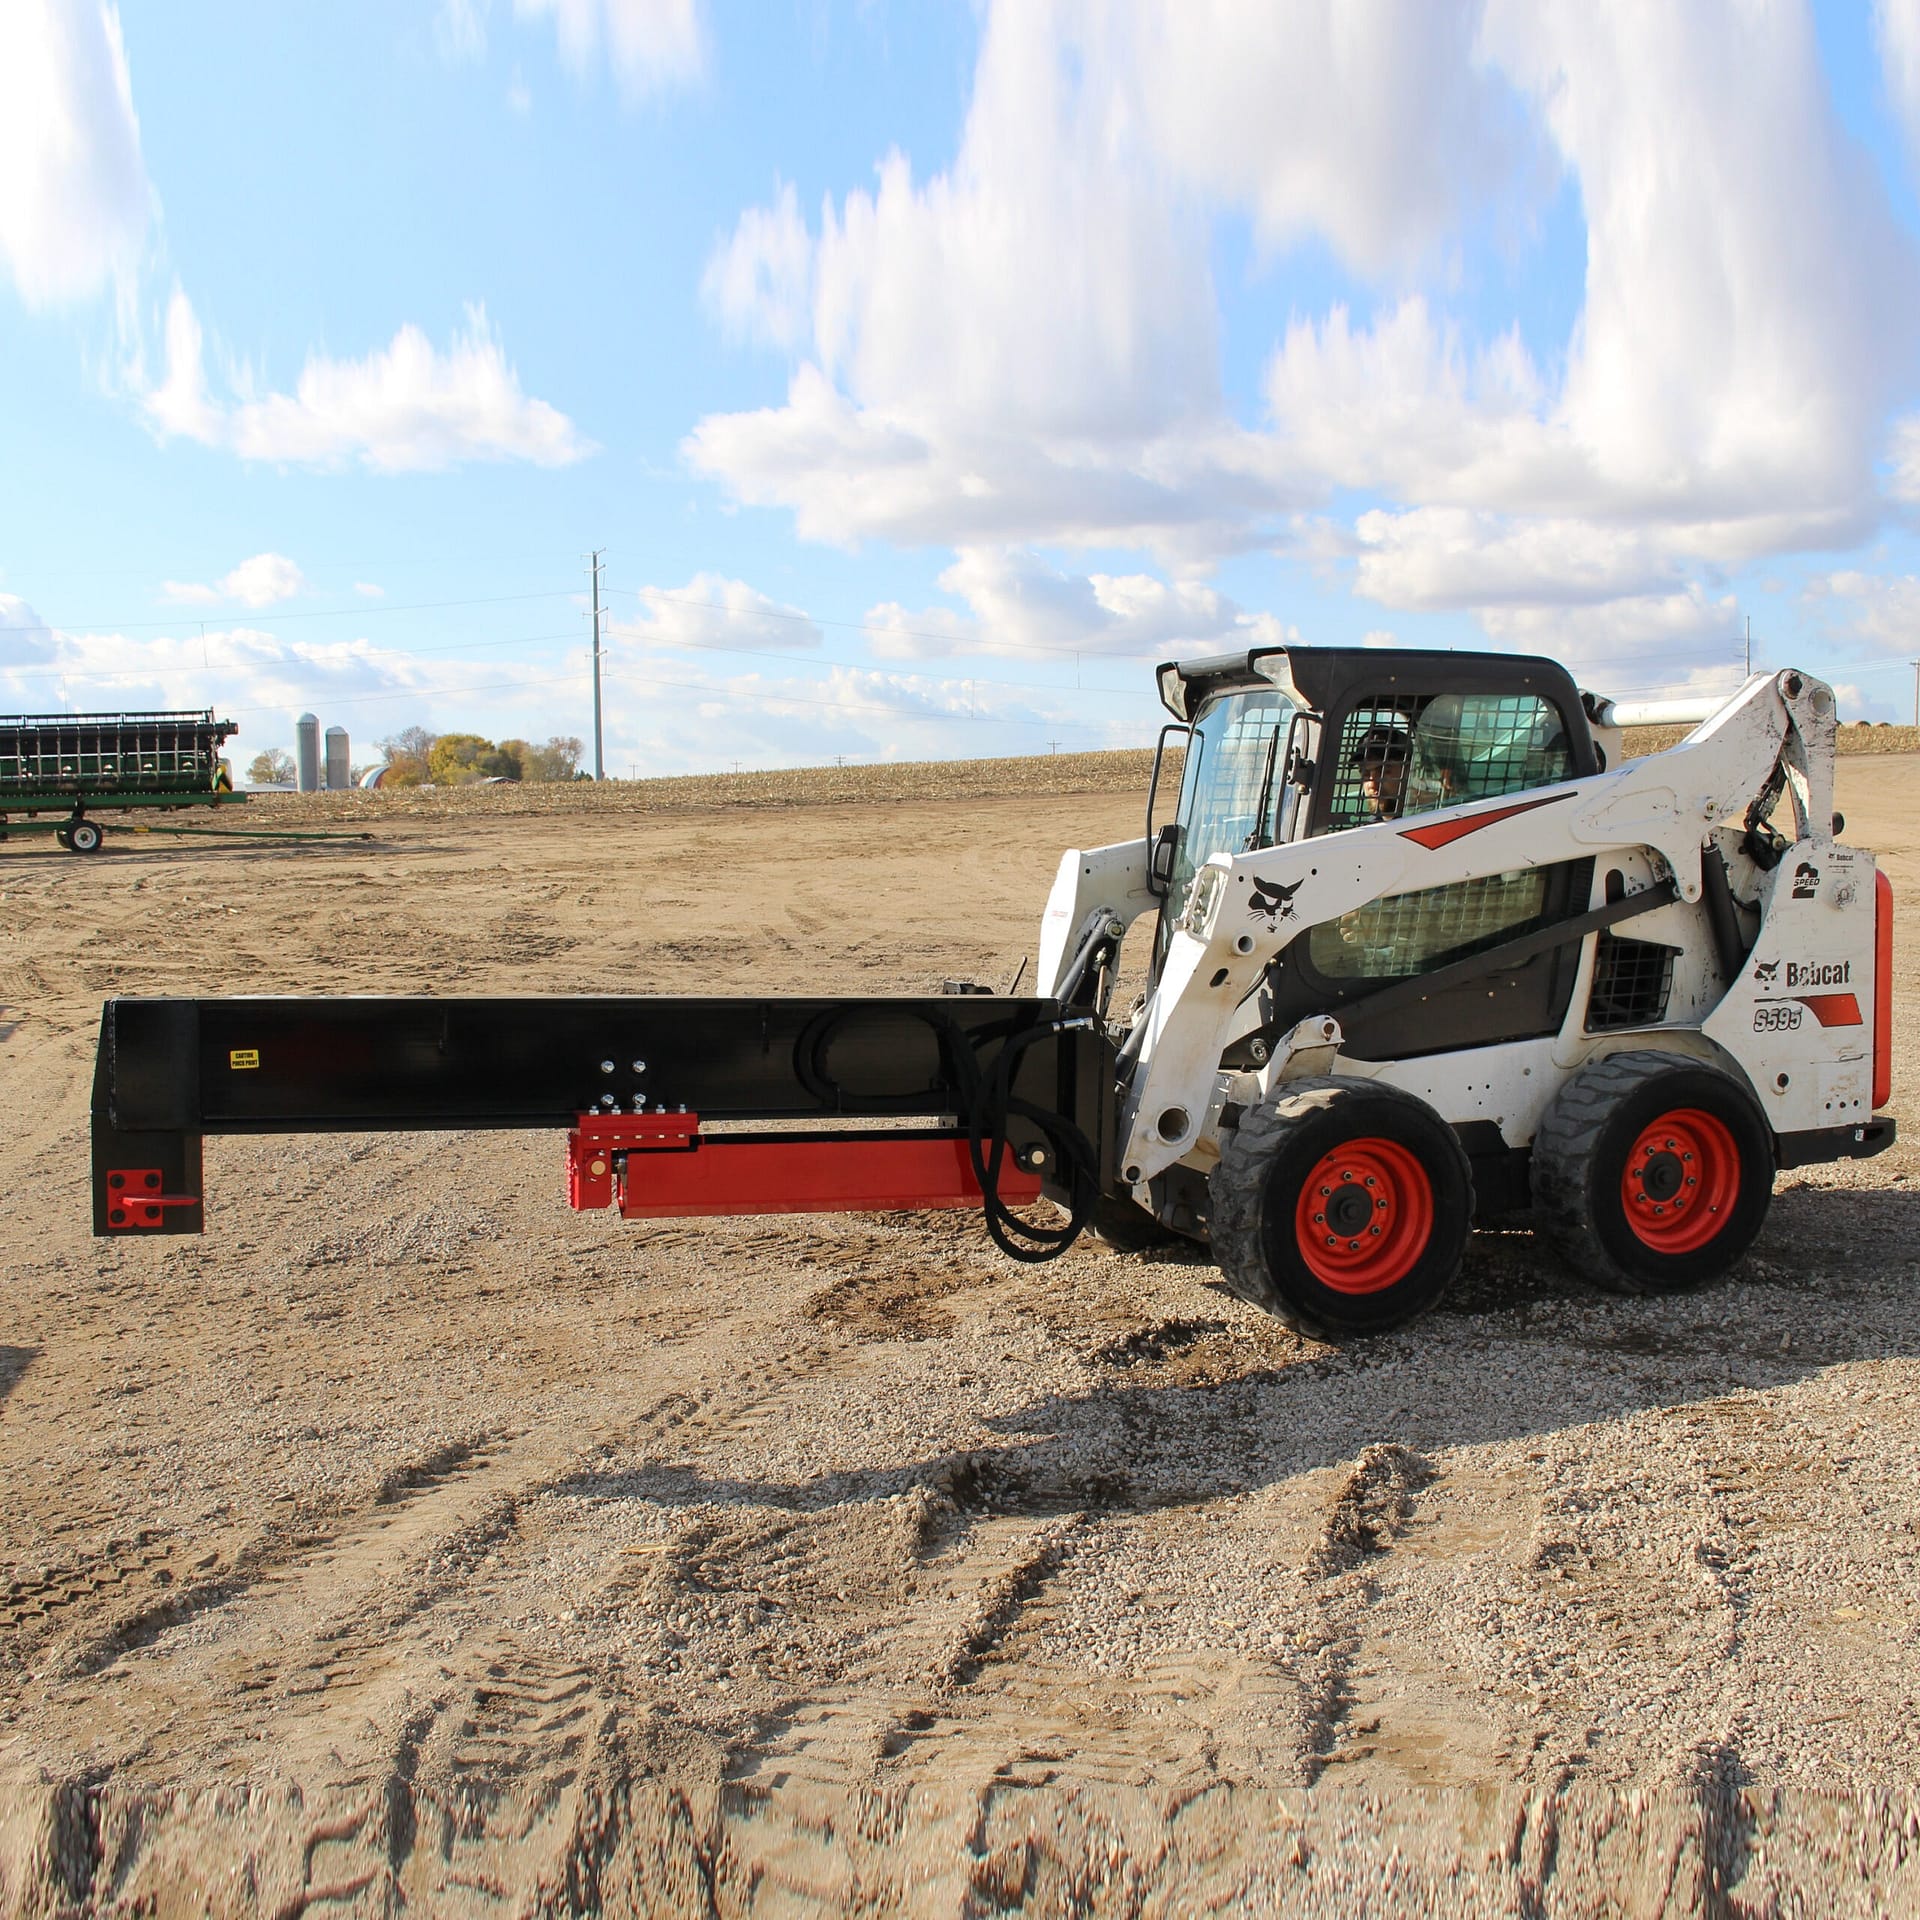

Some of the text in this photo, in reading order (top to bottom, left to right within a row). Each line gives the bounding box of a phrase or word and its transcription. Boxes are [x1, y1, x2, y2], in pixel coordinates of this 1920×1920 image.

[1792, 862, 1818, 899] 2
[1794, 878, 1820, 887] SPEED
[1787, 961, 1850, 987] Bobcat
[1753, 1006, 1803, 1032] S595
